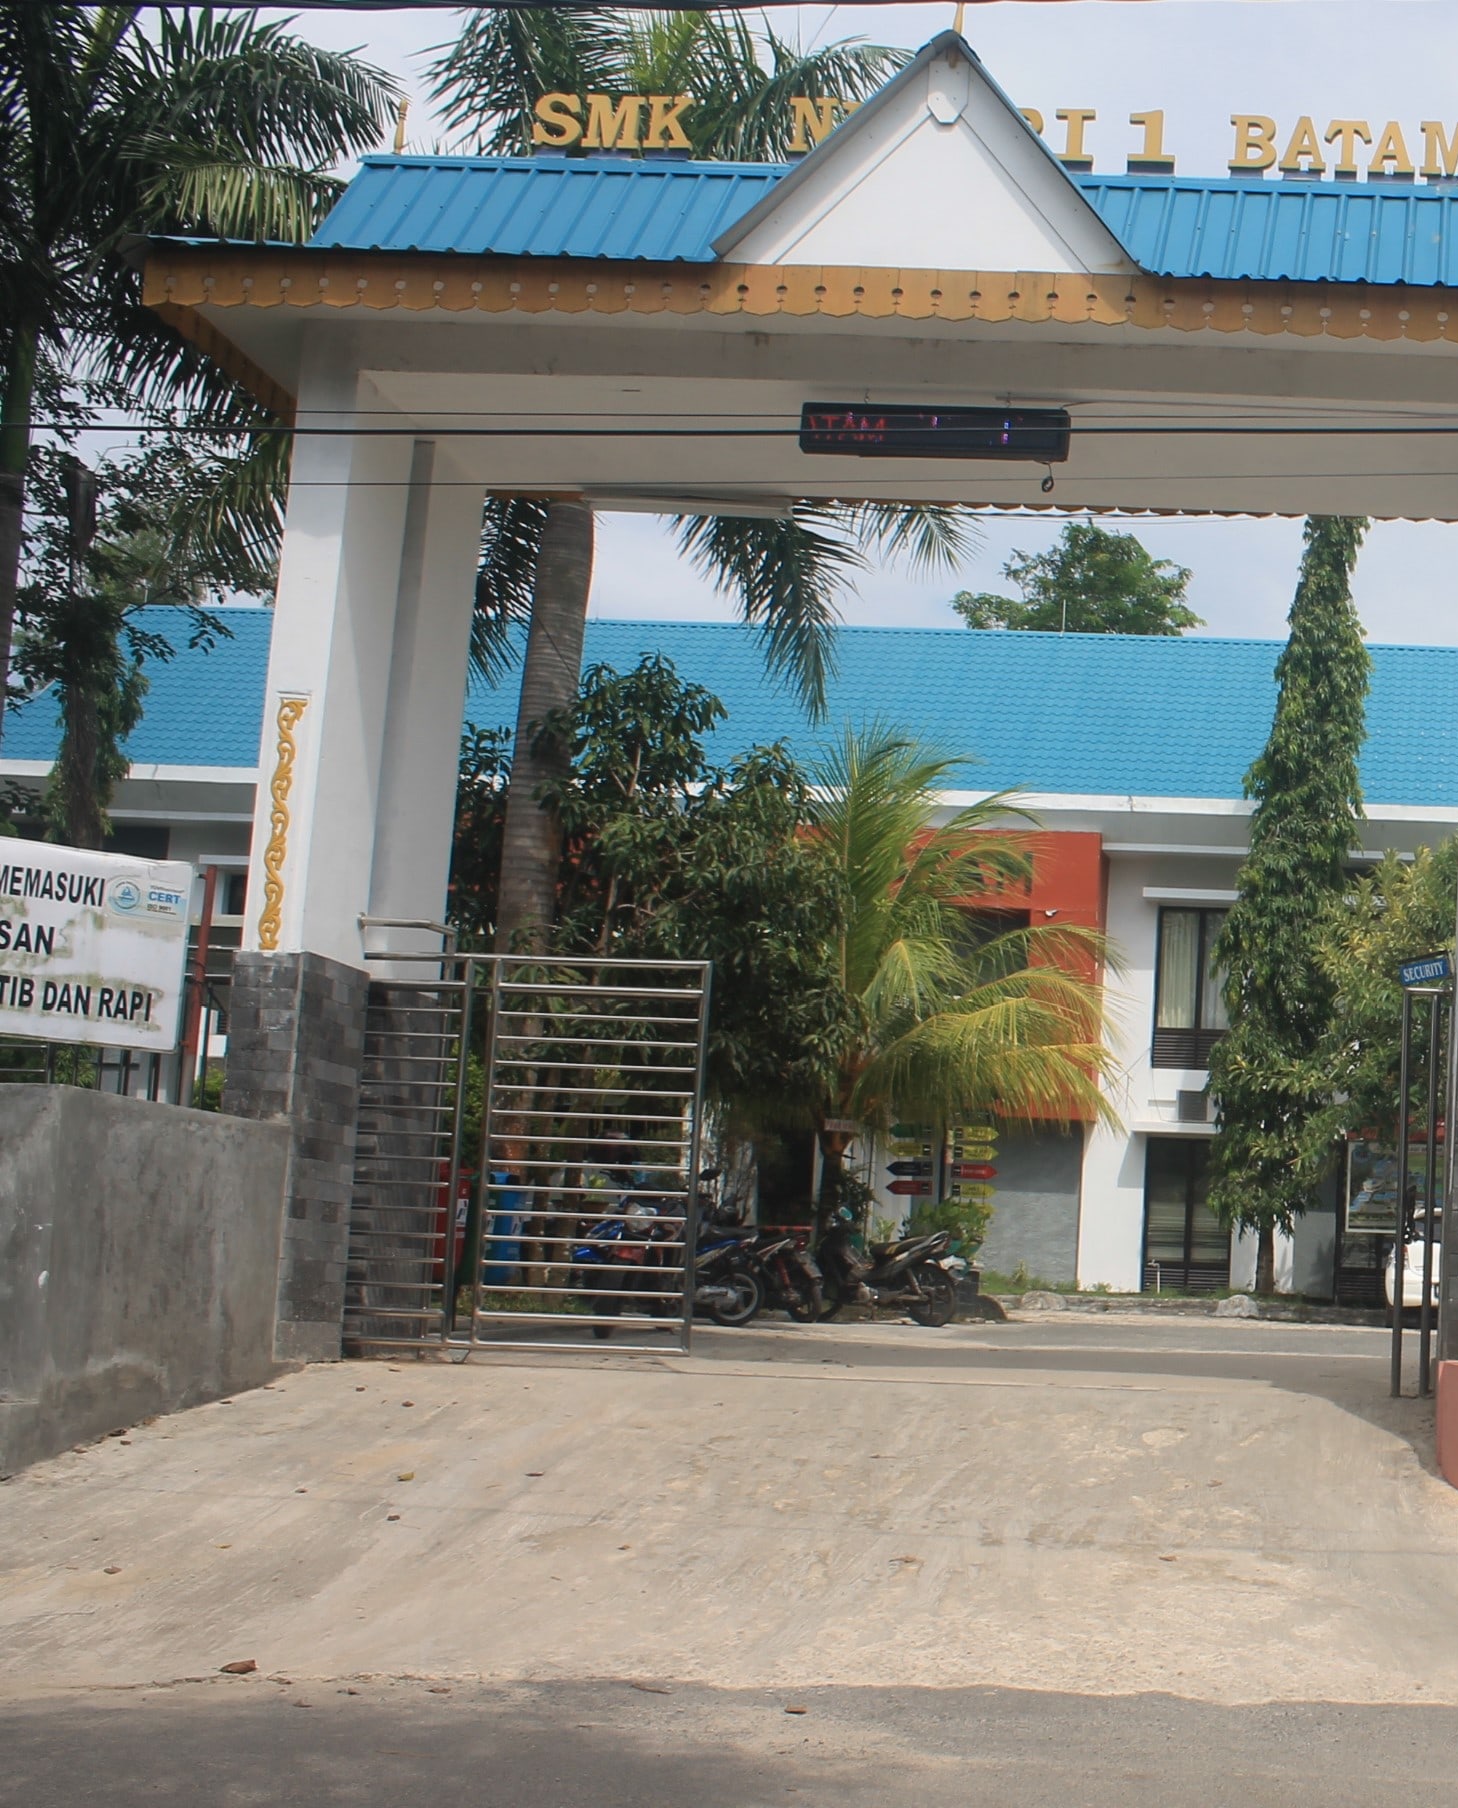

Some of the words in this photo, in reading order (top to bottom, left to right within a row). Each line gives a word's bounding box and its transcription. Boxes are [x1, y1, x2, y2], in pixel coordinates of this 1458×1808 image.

[533, 92, 695, 149] SMK
[1127, 109, 1175, 163] 1
[148, 891, 181, 904] CERT
[1403, 961, 1443, 982] SECURITY
[42, 981, 91, 1015] DAN
[98, 988, 152, 1022] RAPI
